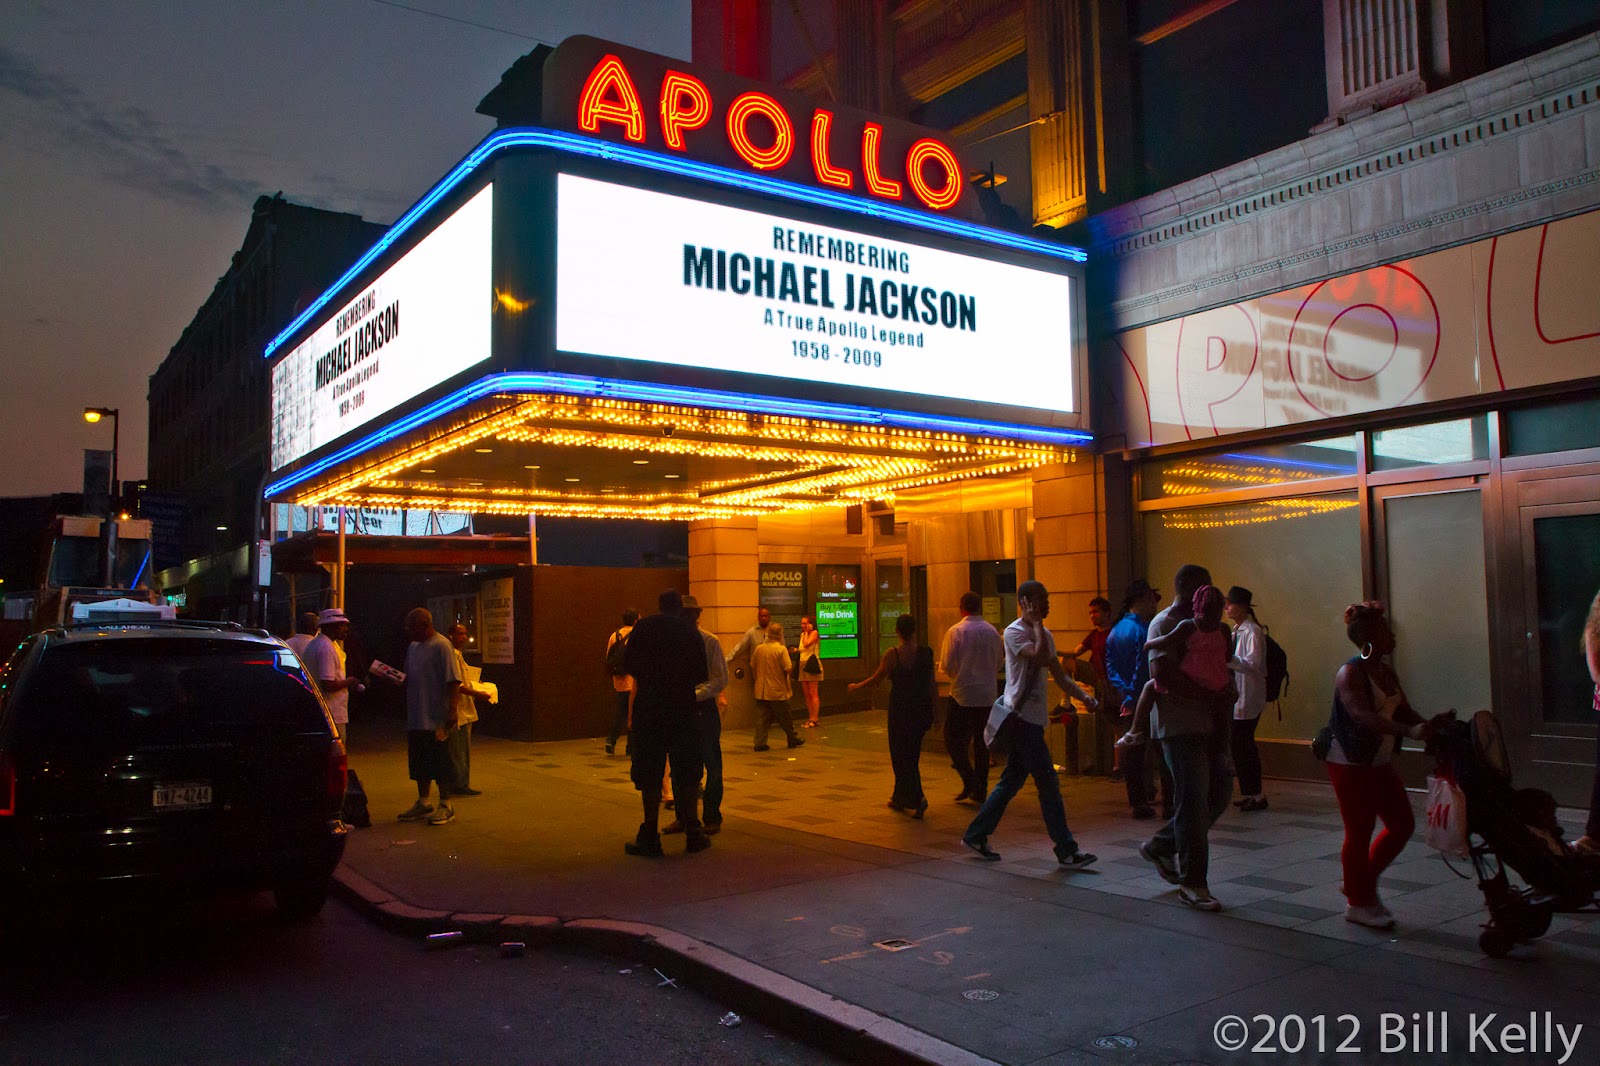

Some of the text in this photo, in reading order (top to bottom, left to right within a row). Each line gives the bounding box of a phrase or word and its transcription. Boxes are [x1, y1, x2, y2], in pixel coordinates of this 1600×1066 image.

[577, 53, 964, 210] APOLLO
[773, 226, 909, 274] REMEMBERING
[683, 243, 976, 332] MICHAEL JACKSON
[337, 290, 376, 338] REMEMBERING
[763, 308, 924, 349] A True Apollo Legend
[316, 299, 399, 392] MICHAEL JACKSON
[761, 571, 803, 581] APOLLO
[836, 610, 854, 618] Drink
